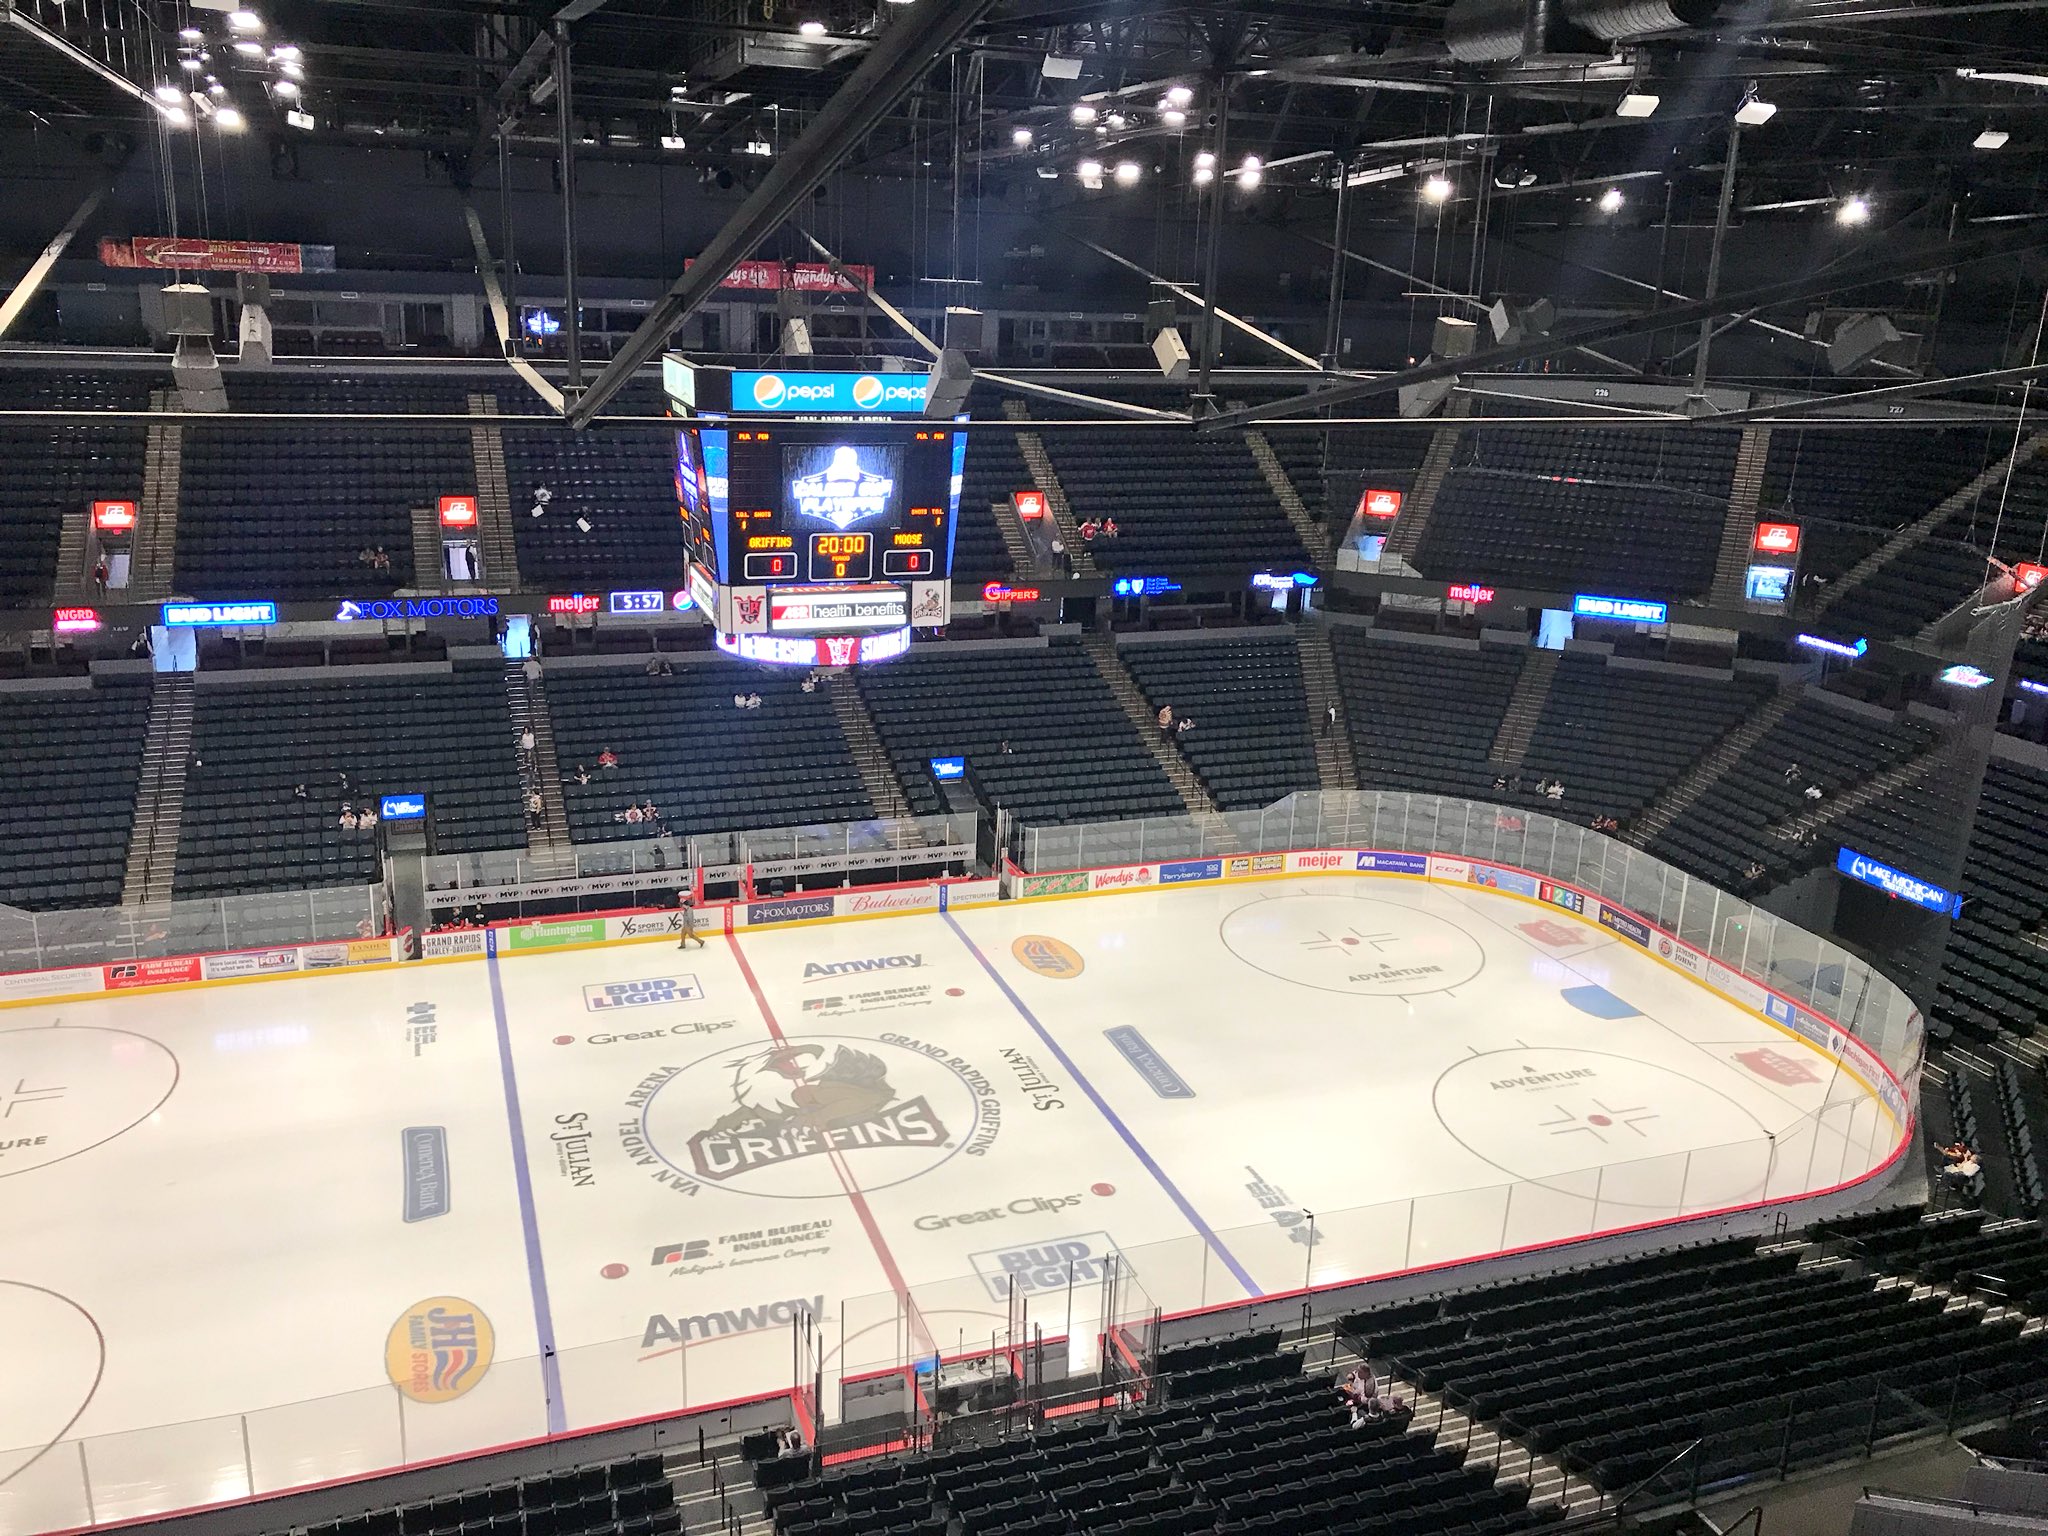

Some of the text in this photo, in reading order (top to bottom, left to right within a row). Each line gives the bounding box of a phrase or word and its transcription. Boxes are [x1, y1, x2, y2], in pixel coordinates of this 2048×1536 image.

[787, 383, 834, 400] pepsi
[885, 386, 926, 401] peps
[1595, 389, 1609, 397] 226
[749, 536, 793, 549] GRIFFINS
[817, 536, 865, 554] 20:00
[894, 533, 923, 546] MOOSE
[773, 559, 783, 572] 0
[909, 555, 919, 569] 0
[835, 563, 846, 577] 0
[984, 581, 1040, 601] GIPPER'S
[1450, 585, 1495, 603] meijer
[358, 598, 499, 618] FOX MOTORS
[550, 594, 600, 613] meijer
[622, 594, 661, 610] 5:57
[1578, 599, 1664, 619] BUD LIGHT
[57, 609, 94, 621] WGRD
[168, 606, 272, 623] BUD LIGHT
[812, 604, 853, 619] health
[855, 602, 904, 617] benefits
[914, 607, 943, 619] GRIFFINS
[874, 856, 892, 864] MVP
[900, 854, 918, 862] MVP
[926, 852, 943, 860] MVP
[951, 849, 969, 858] MVP
[1298, 852, 1344, 869] meijer
[765, 866, 784, 875] MVP
[793, 863, 811, 872] MVP
[820, 861, 839, 870] MVP
[848, 859, 865, 867] MVP
[1376, 859, 1408, 867] MACATAWA
[1434, 865, 1464, 875] CCM
[650, 877, 669, 885] MVP
[708, 871, 728, 880] MVP
[1095, 869, 1134, 889] Wendy's
[1162, 870, 1203, 880] Terryberry
[560, 885, 580, 894] MVP
[591, 882, 611, 891] MVP
[621, 879, 640, 889] MVP
[1867, 863, 1944, 903] LAKE MICHIGAN
[436, 895, 457, 904] MVP
[468, 893, 488, 902] MVP
[500, 890, 519, 899] MVP
[530, 888, 550, 896] MVP
[953, 891, 1000, 901] SPECTRUM HEA
[850, 893, 932, 912] Budweiser
[764, 903, 830, 918] FOX MOTORS
[534, 924, 594, 937] Huntington
[426, 933, 481, 948] GRAND RAPIDS
[426, 944, 482, 956] HARLEY-DAVIDSON
[1675, 945, 1699, 962] JIMMY
[141, 959, 194, 970] FARM BUREAU
[223, 959, 238, 967] local
[259, 954, 294, 966] FOX 17
[803, 953, 922, 978] Amway
[1674, 953, 1697, 971] JOHN'S
[147, 966, 191, 976] INSURANCE
[221, 965, 236, 973] what
[1348, 965, 1445, 983] ADVENTURE
[4, 971, 92, 986] CENTENNIAL SECURITIES
[604, 979, 678, 997] BUD
[848, 984, 931, 1000] FARM BUREAU
[592, 987, 694, 1009] LIGHT
[860, 991, 928, 1004] INSURANCE
[587, 1019, 735, 1045] Great Clips
[1845, 1044, 1869, 1072] Michigan
[1868, 1060, 1880, 1081] First
[999, 1047, 1060, 1094] JULIAN
[1489, 1068, 1597, 1091] ADVENTURE
[879, 1032, 1001, 1157] GRAND RAPIDS GRIFFINS
[618, 1065, 701, 1198] VAN ANDEL ARENA
[701, 1102, 940, 1174] GRIFFINS
[550, 1131, 596, 1187] JULIAN
[419, 1180, 439, 1211] Bank
[913, 1194, 1082, 1231] Great Clips
[718, 1219, 832, 1245] FARM BUREAU
[732, 1230, 828, 1253] INSURANCE
[669, 1246, 831, 1278] Michigan's Insurance Company
[997, 1241, 1091, 1274] BUD
[990, 1255, 1121, 1296] LIGHT
[641, 1294, 824, 1348] Amway
